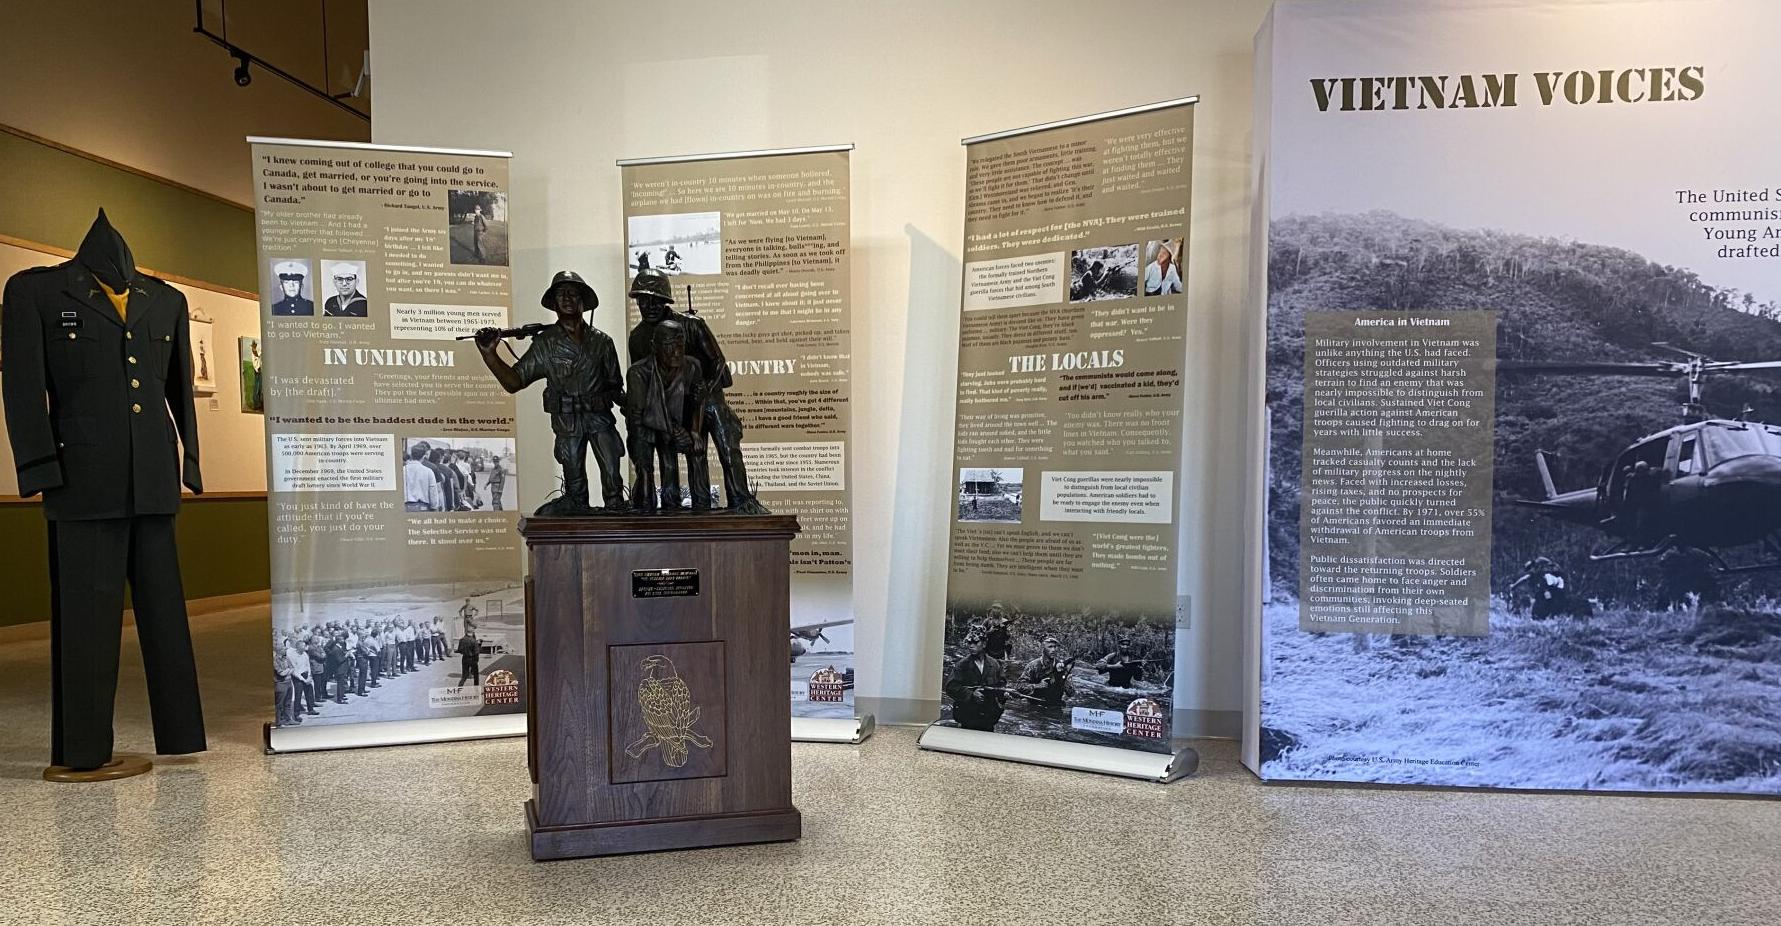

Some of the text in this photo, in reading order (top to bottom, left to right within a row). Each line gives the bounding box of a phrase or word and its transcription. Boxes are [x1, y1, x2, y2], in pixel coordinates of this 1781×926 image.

[1310, 66, 1705, 111] VIETNAM VOICES
[299, 158, 333, 167] coming
[364, 161, 395, 170] college
[262, 169, 299, 178] Canada,
[403, 176, 428, 185] going
[341, 186, 355, 194] get
[1675, 190, 1706, 203] The
[1713, 189, 1768, 202] United
[1689, 208, 1781, 222] communis
[795, 234, 826, 242] Vietnam],
[1704, 227, 1756, 241] Young
[1717, 244, 1779, 257] drafted
[324, 348, 454, 366] IN UNIFORM
[1345, 349, 1384, 357] anything
[1008, 350, 1123, 372] THE LOCALS
[726, 359, 796, 375] OUNTRY
[1360, 369, 1402, 377] struggled
[301, 376, 354, 384] devastated
[270, 387, 281, 397] by
[285, 387, 304, 396] [the
[1345, 388, 1393, 396] impossible
[1407, 389, 1458, 397] distinguish
[1426, 399, 1444, 407] Viet
[1447, 398, 1470, 407] Cong
[1314, 408, 1348, 416] guerilla
[1379, 418, 1414, 427] fighting
[1428, 419, 1449, 427] drag
[1127, 715, 1161, 724] WESTERN
[1127, 722, 1162, 731] HERITAGE
[1126, 729, 1161, 738] CENTER
